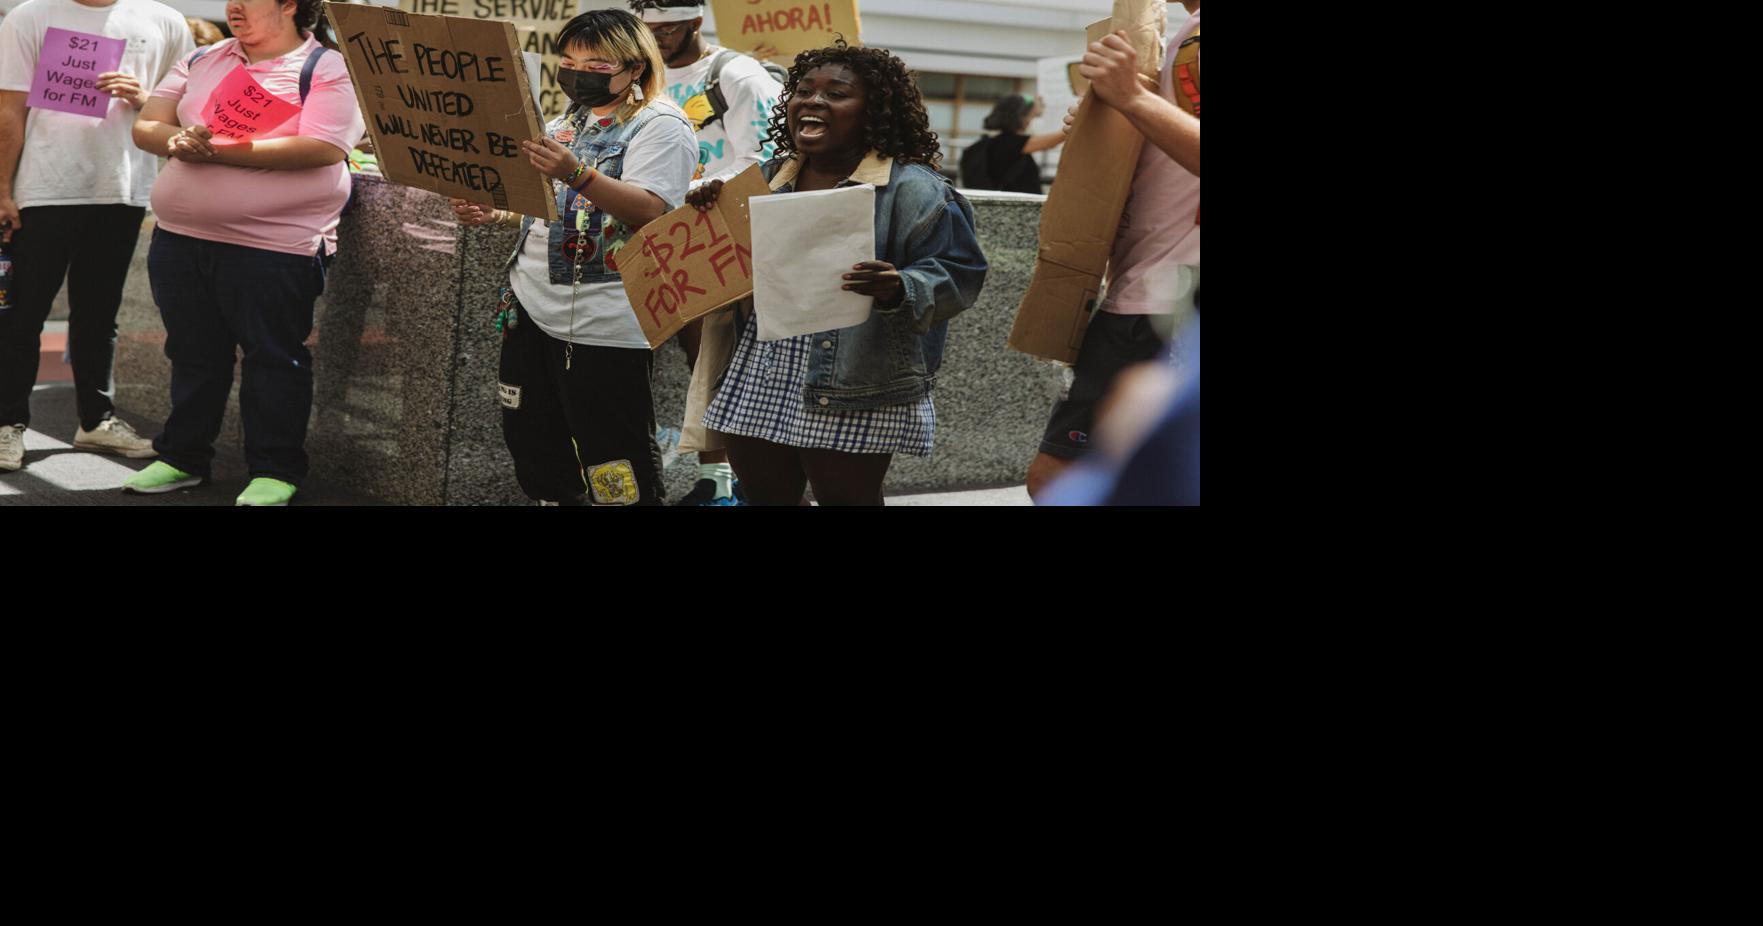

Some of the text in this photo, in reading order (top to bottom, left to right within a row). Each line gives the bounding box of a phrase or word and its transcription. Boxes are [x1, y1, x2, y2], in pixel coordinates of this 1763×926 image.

[474, 0, 576, 20] SERVICE
[741, 3, 833, 35] AHORA!
[68, 36, 98, 52] $21
[348, 31, 409, 75] THE
[413, 43, 506, 82] PEOPLE
[62, 55, 97, 71] Just
[43, 88, 97, 107] for FM
[227, 99, 261, 120] Just
[243, 85, 273, 108] $21
[397, 84, 474, 117] UNITED
[375, 113, 518, 158] WILL NEVER BE
[408, 146, 501, 194] DEFEATED
[642, 209, 729, 278] $21
[644, 268, 706, 329] FOR
